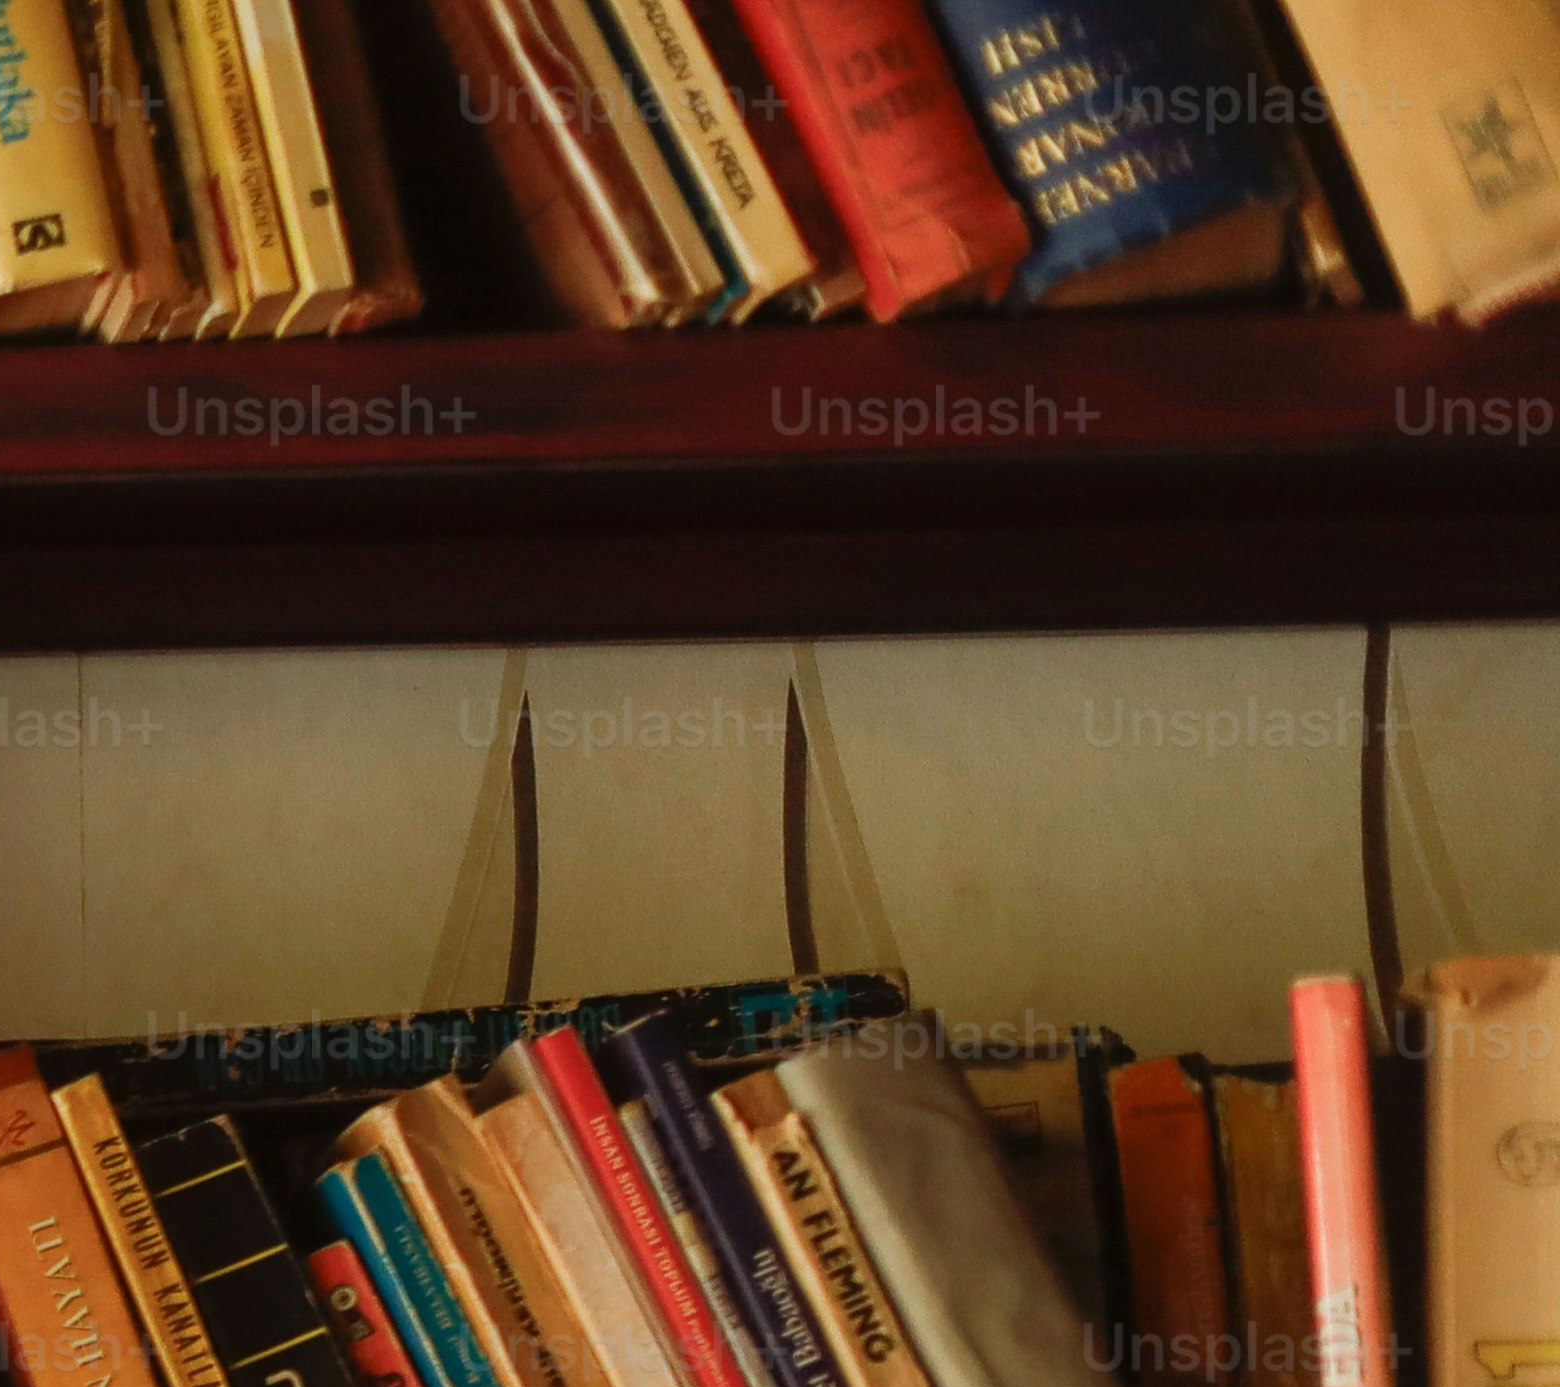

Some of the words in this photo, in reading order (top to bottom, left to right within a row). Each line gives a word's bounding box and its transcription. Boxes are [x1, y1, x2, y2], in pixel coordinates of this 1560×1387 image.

[707, 136, 756, 208] KRETA
[92, 1135, 165, 1269] KORKUNUN
[803, 1210, 898, 1367] FLEMING
